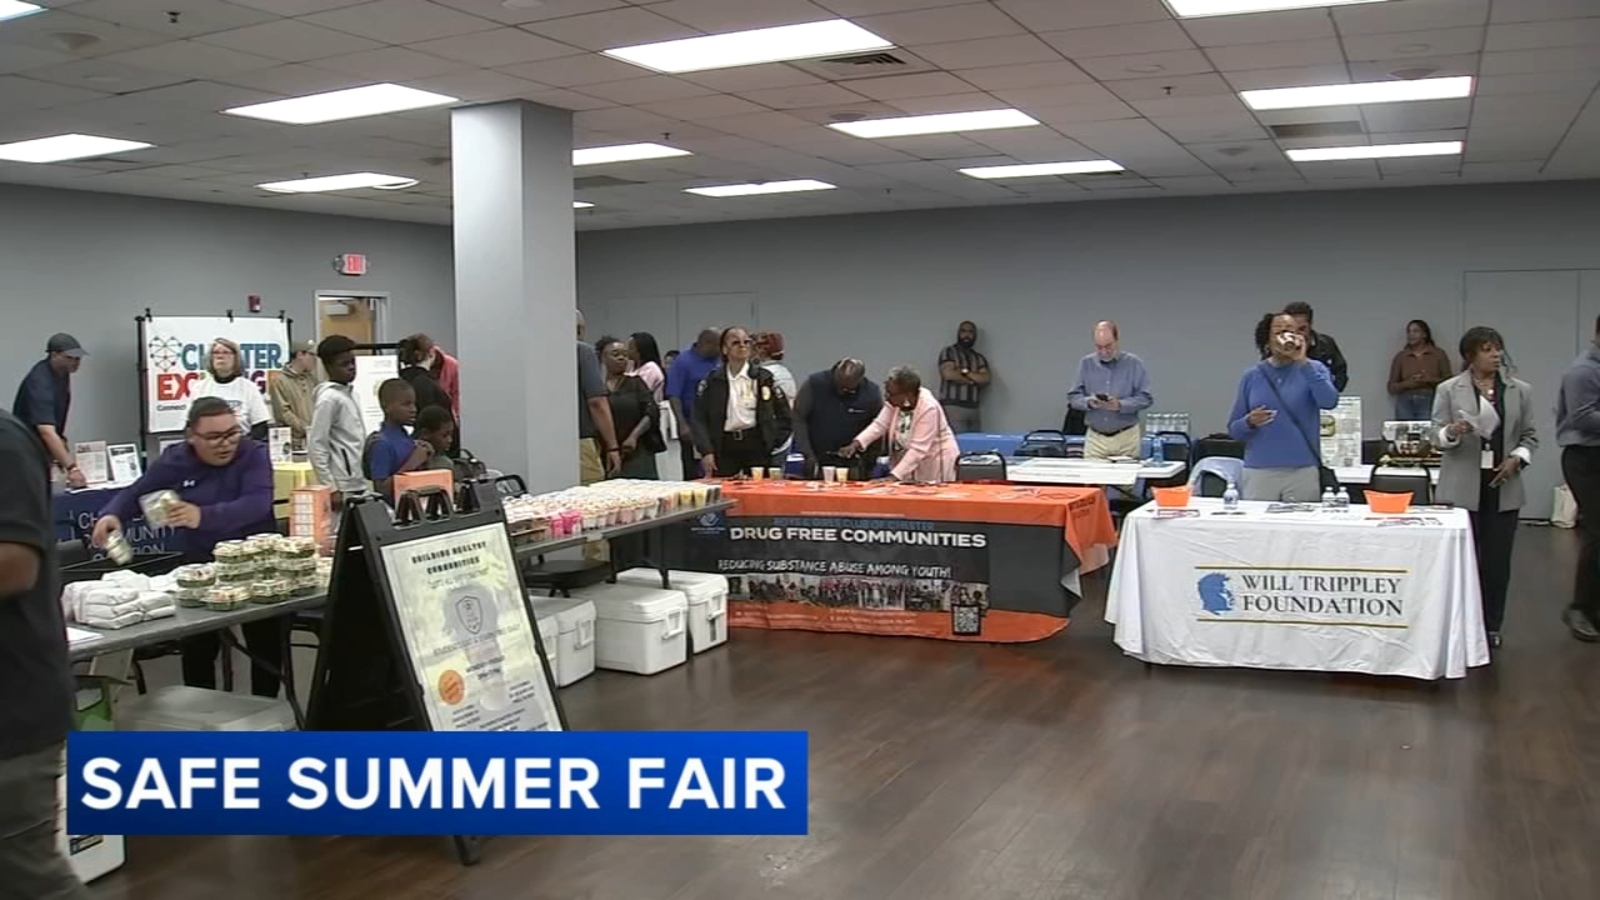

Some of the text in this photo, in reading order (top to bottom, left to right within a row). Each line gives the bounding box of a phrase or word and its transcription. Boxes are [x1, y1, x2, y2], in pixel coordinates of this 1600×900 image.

[730, 527, 783, 541] DRUG
[786, 528, 838, 541] FREE
[840, 529, 987, 548] COMMUNITIES
[718, 559, 766, 571] REDUCING
[766, 560, 827, 573] SUBSTANCE
[829, 562, 865, 574] ABUSE
[866, 563, 909, 576] AMONG
[1242, 574, 1401, 594] WILL TRIPPLEY
[1242, 595, 1403, 617] FOUNDATION
